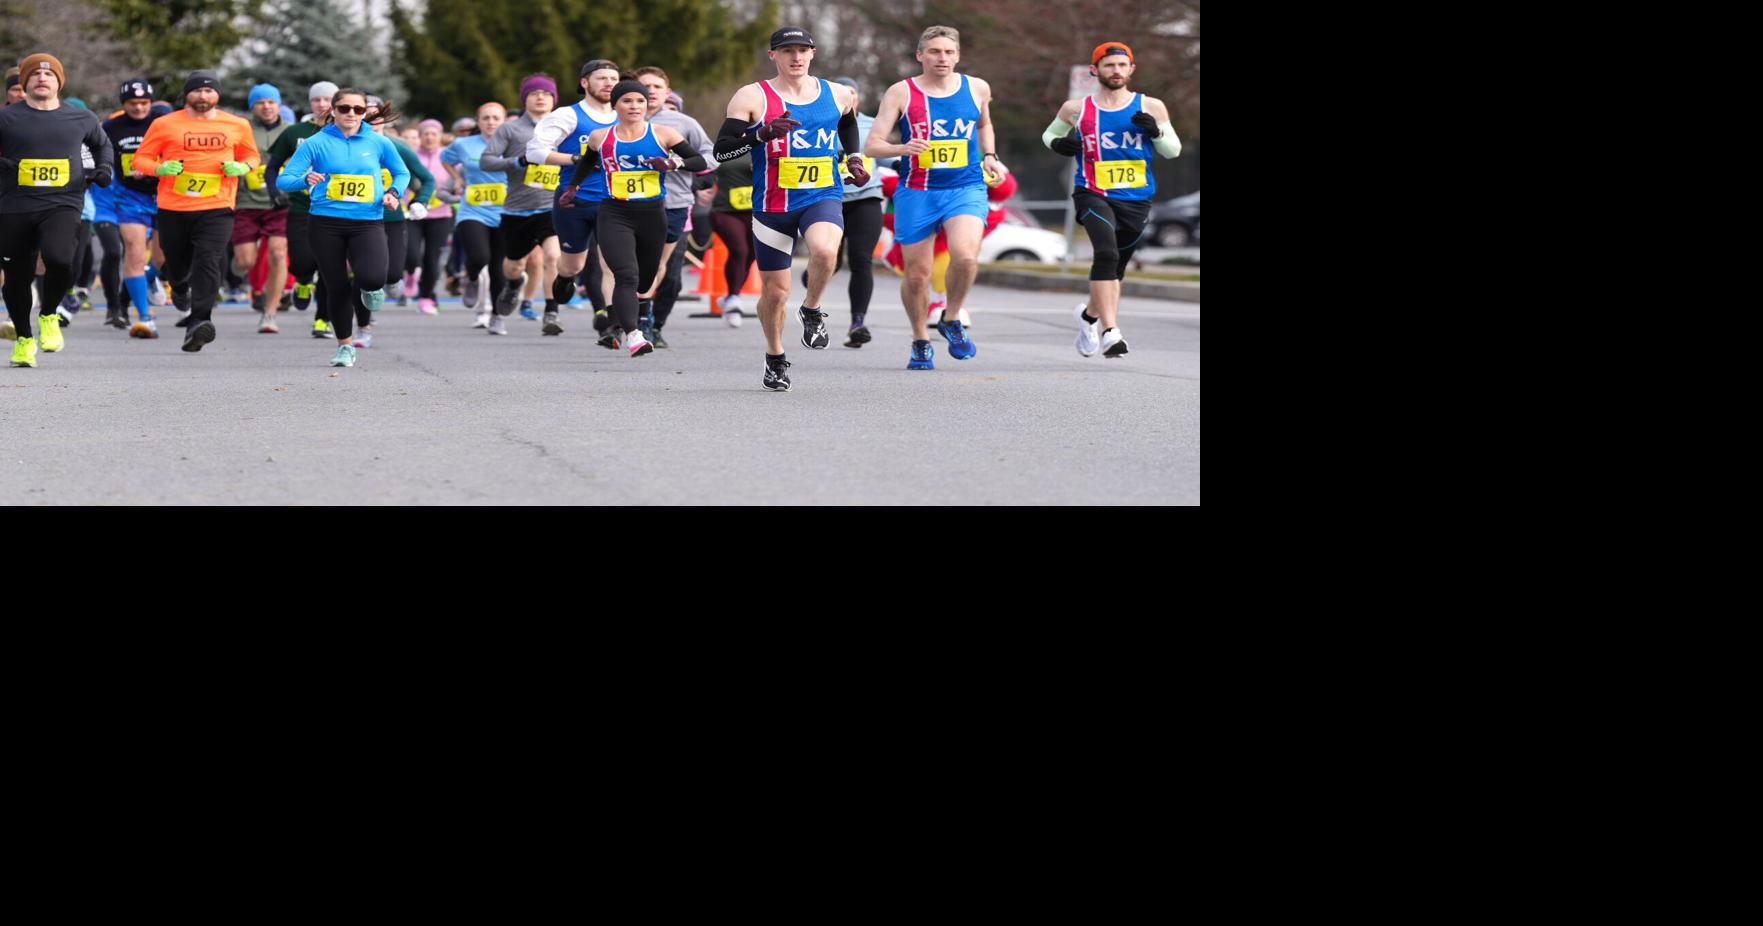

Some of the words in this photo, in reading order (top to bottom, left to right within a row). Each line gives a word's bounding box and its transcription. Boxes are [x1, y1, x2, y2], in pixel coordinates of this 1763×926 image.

[912, 118, 976, 140] F&M
[188, 136, 221, 147] run
[1083, 131, 1143, 152] F&M
[716, 144, 753, 161] saucony
[929, 148, 957, 163] 167
[31, 167, 59, 181] 180
[533, 170, 559, 185] 260
[797, 166, 819, 182] 70
[1106, 168, 1136, 183] 178
[187, 179, 207, 193] 27
[339, 181, 366, 197] 192
[626, 178, 646, 193] 81
[474, 189, 498, 202] 210
